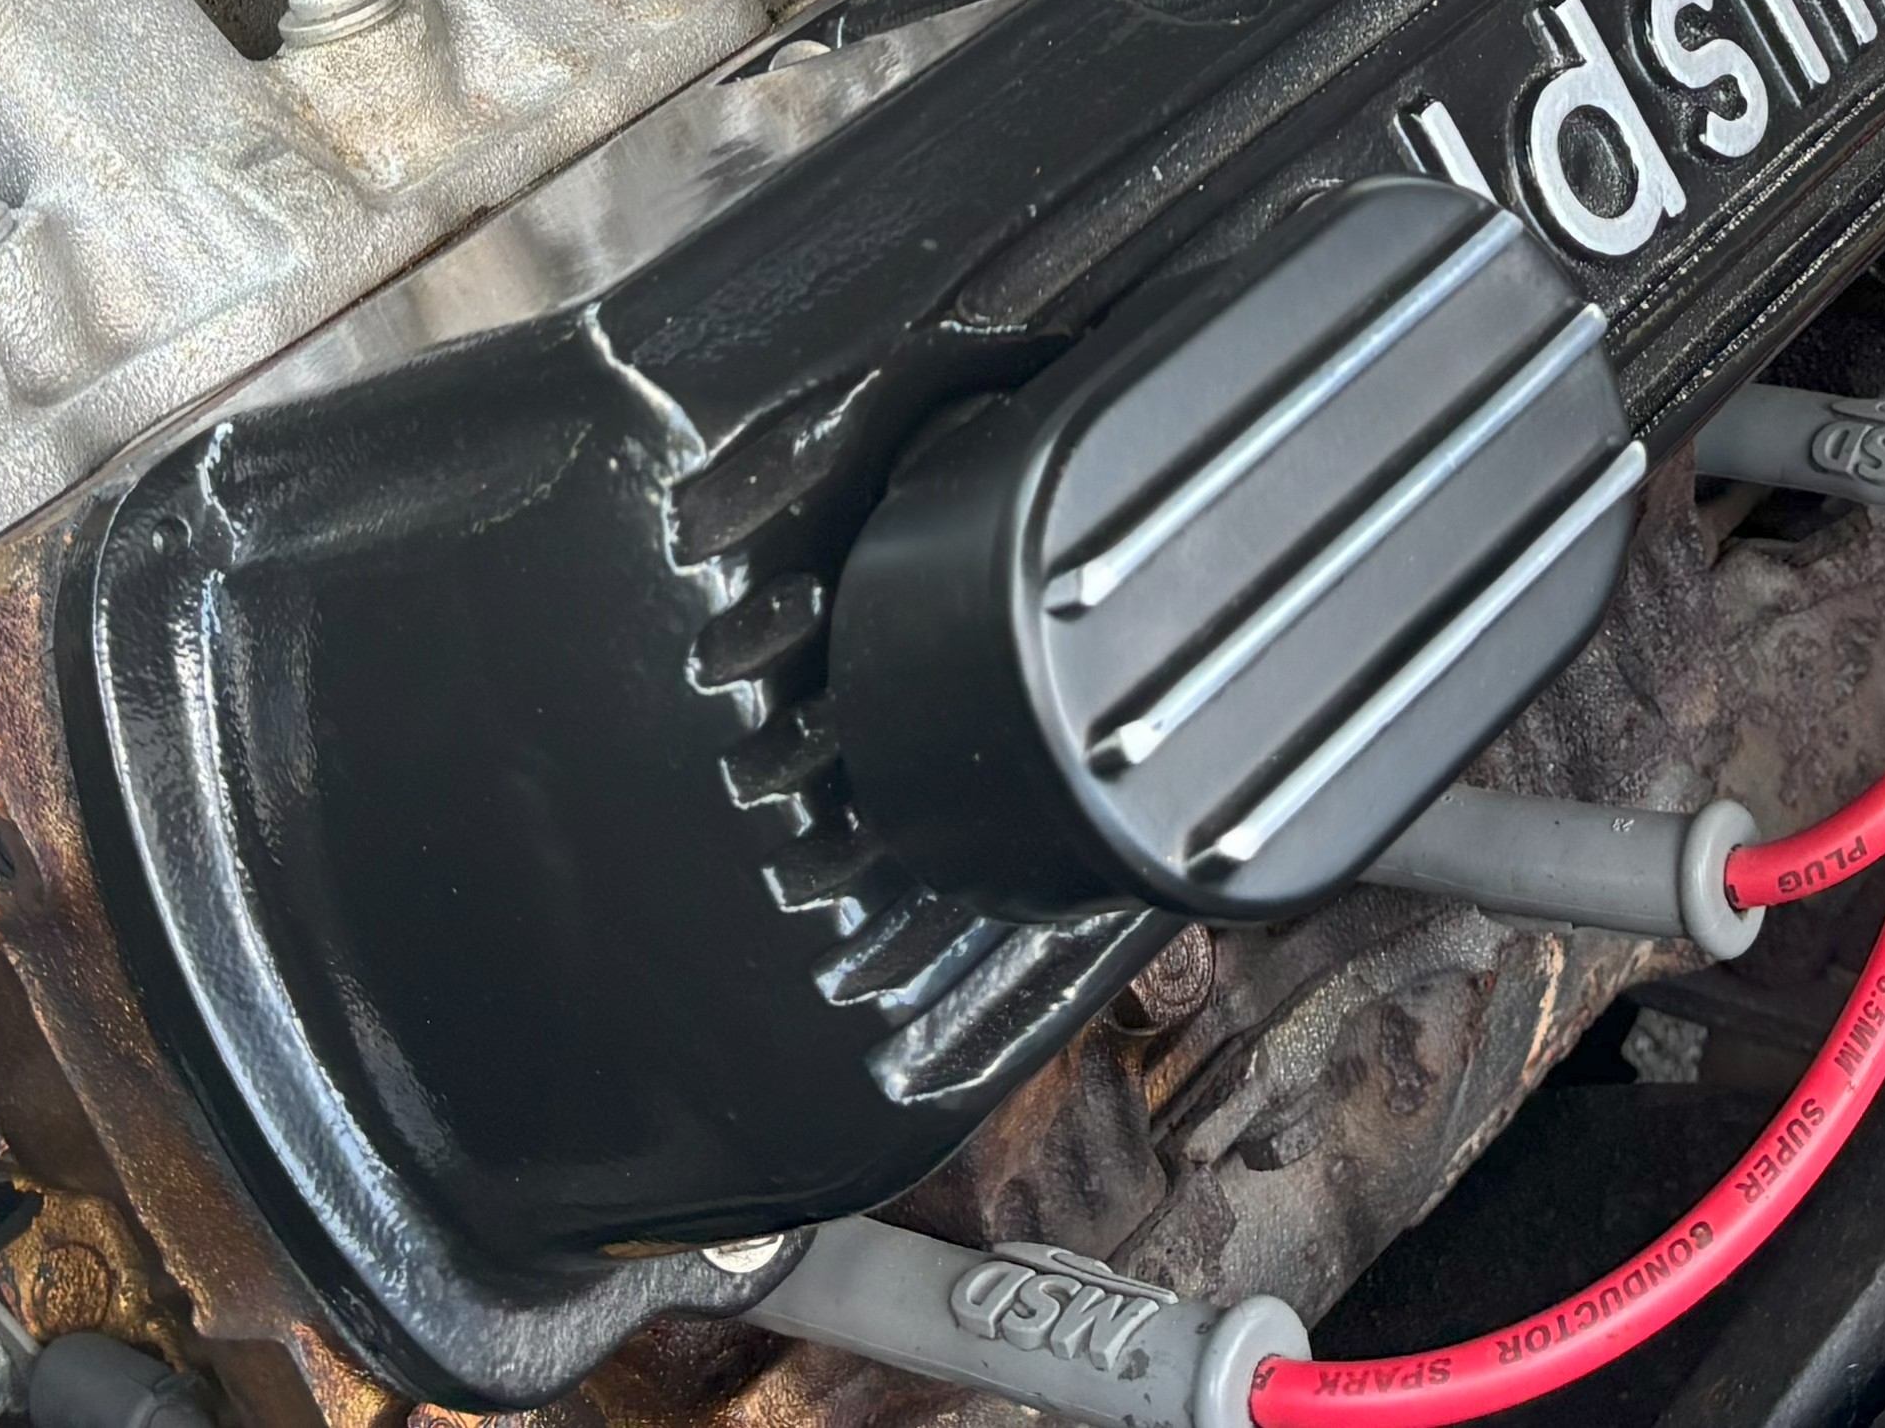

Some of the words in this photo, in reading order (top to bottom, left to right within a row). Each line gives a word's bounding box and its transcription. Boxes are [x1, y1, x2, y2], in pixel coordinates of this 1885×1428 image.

[1777, 835, 1869, 894] PLUG
[1734, 1096, 1827, 1205] SUPER
[950, 1258, 1160, 1372] MSD
[1495, 1220, 1715, 1367] CONDUCTOR
[1313, 1355, 1454, 1398] SPARK
